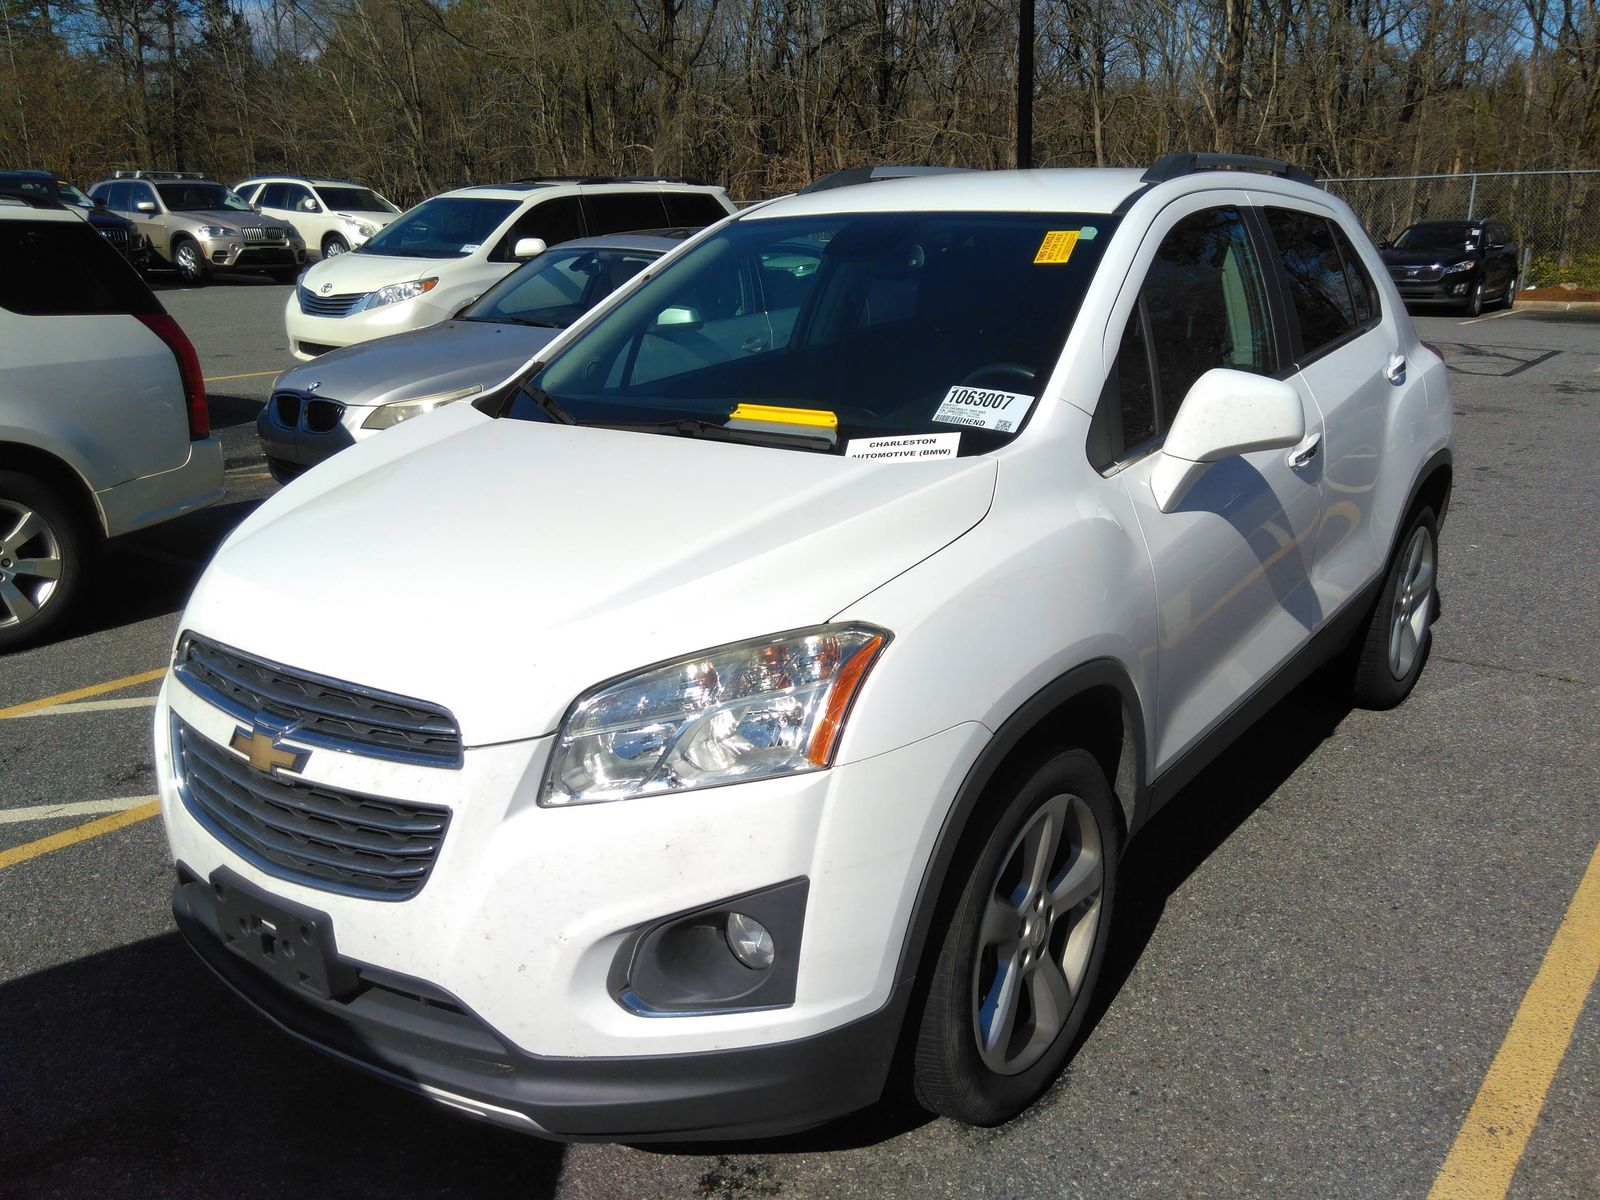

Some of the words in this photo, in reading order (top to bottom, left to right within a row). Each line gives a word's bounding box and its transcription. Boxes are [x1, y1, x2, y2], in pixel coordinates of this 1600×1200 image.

[949, 389, 1015, 410] 1063007
[962, 417, 986, 427] HEND
[869, 438, 937, 448] CHARLESTON
[919, 449, 951, 457] (BMW)
